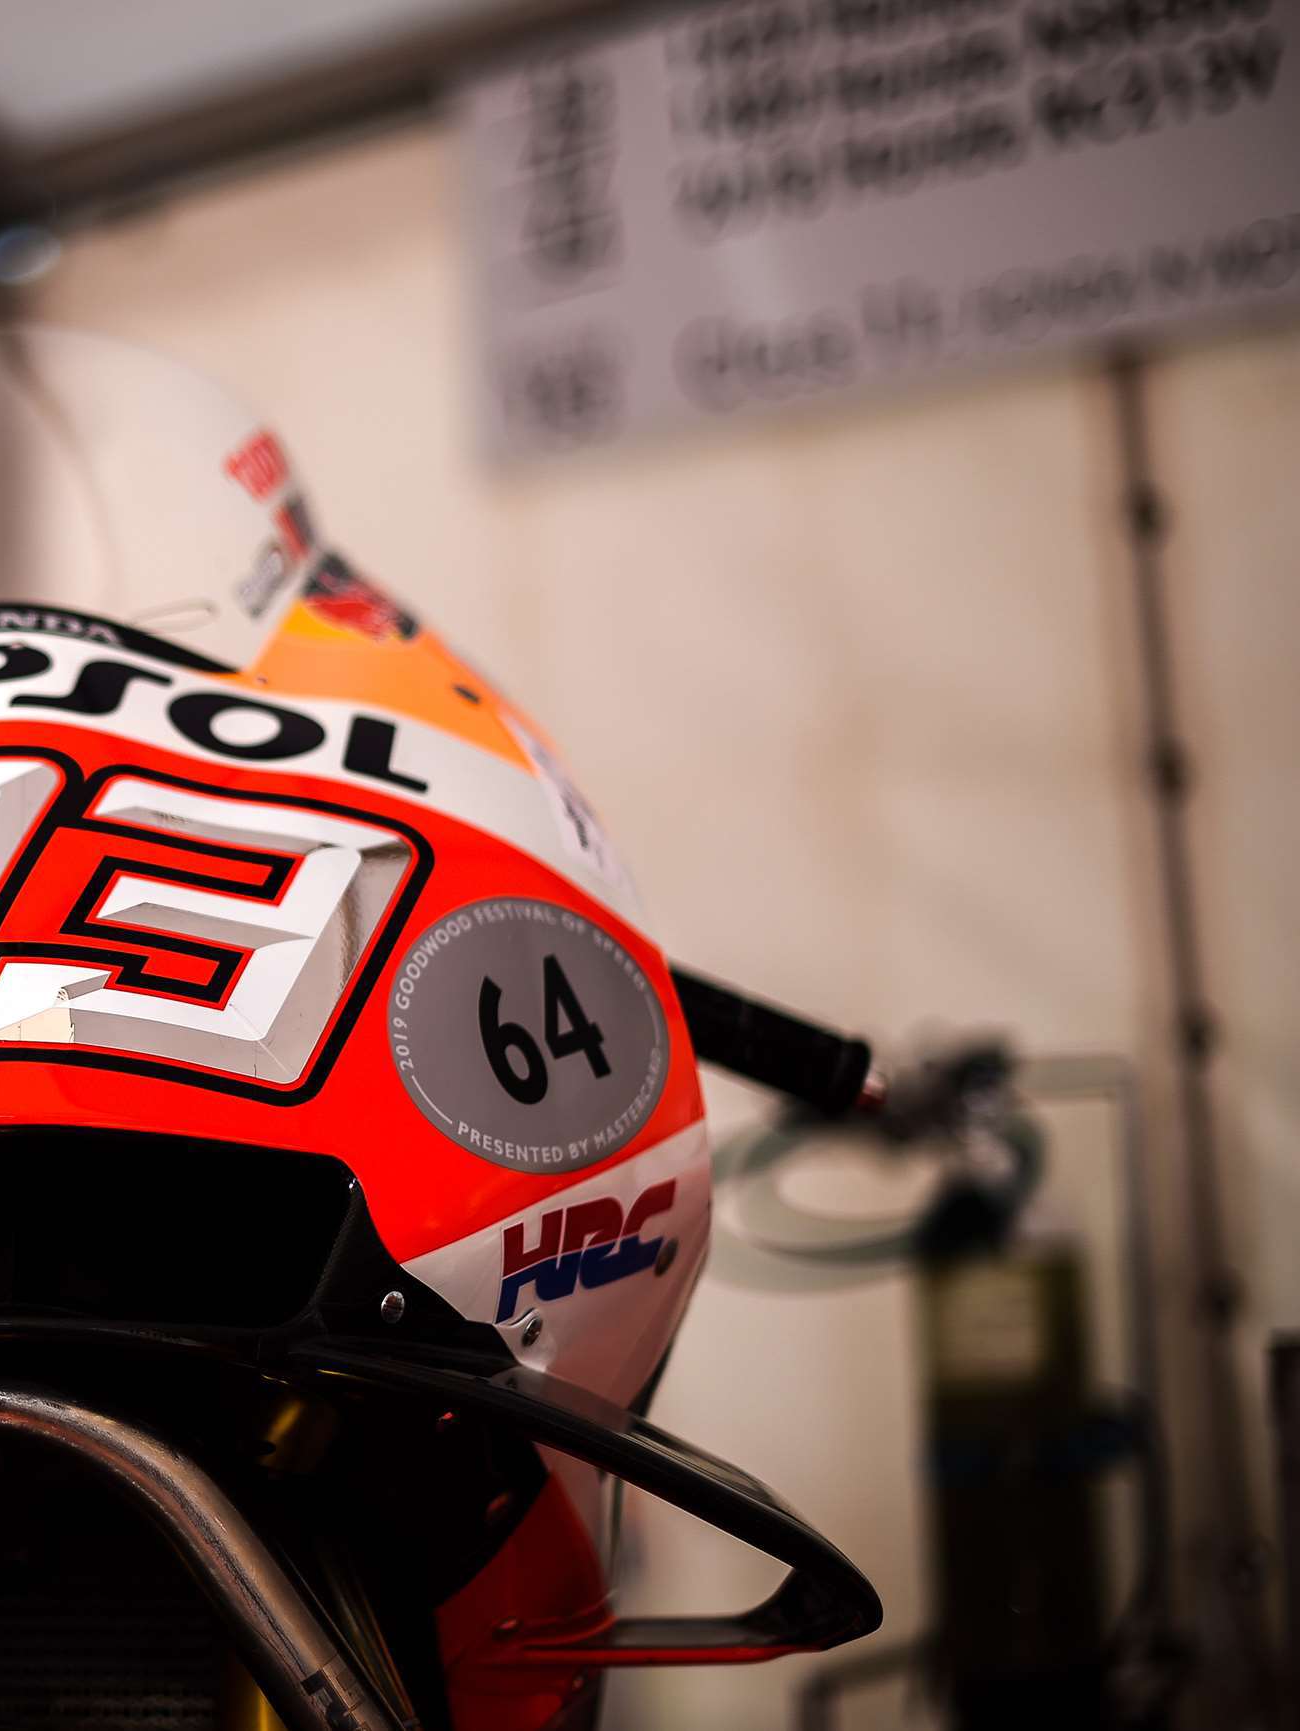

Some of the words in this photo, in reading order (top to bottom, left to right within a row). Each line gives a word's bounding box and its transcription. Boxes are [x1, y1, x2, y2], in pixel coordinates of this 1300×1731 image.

[395, 914, 472, 1010] GOODWOOD
[474, 903, 556, 926] FESTIVAL
[393, 1017, 414, 1071] 2019
[478, 954, 611, 1105] 64
[457, 1121, 564, 1163] PRESENTED
[568, 1138, 588, 1159] BY
[594, 1048, 661, 1151] MASTERCARD
[495, 1178, 677, 1324] HRC
